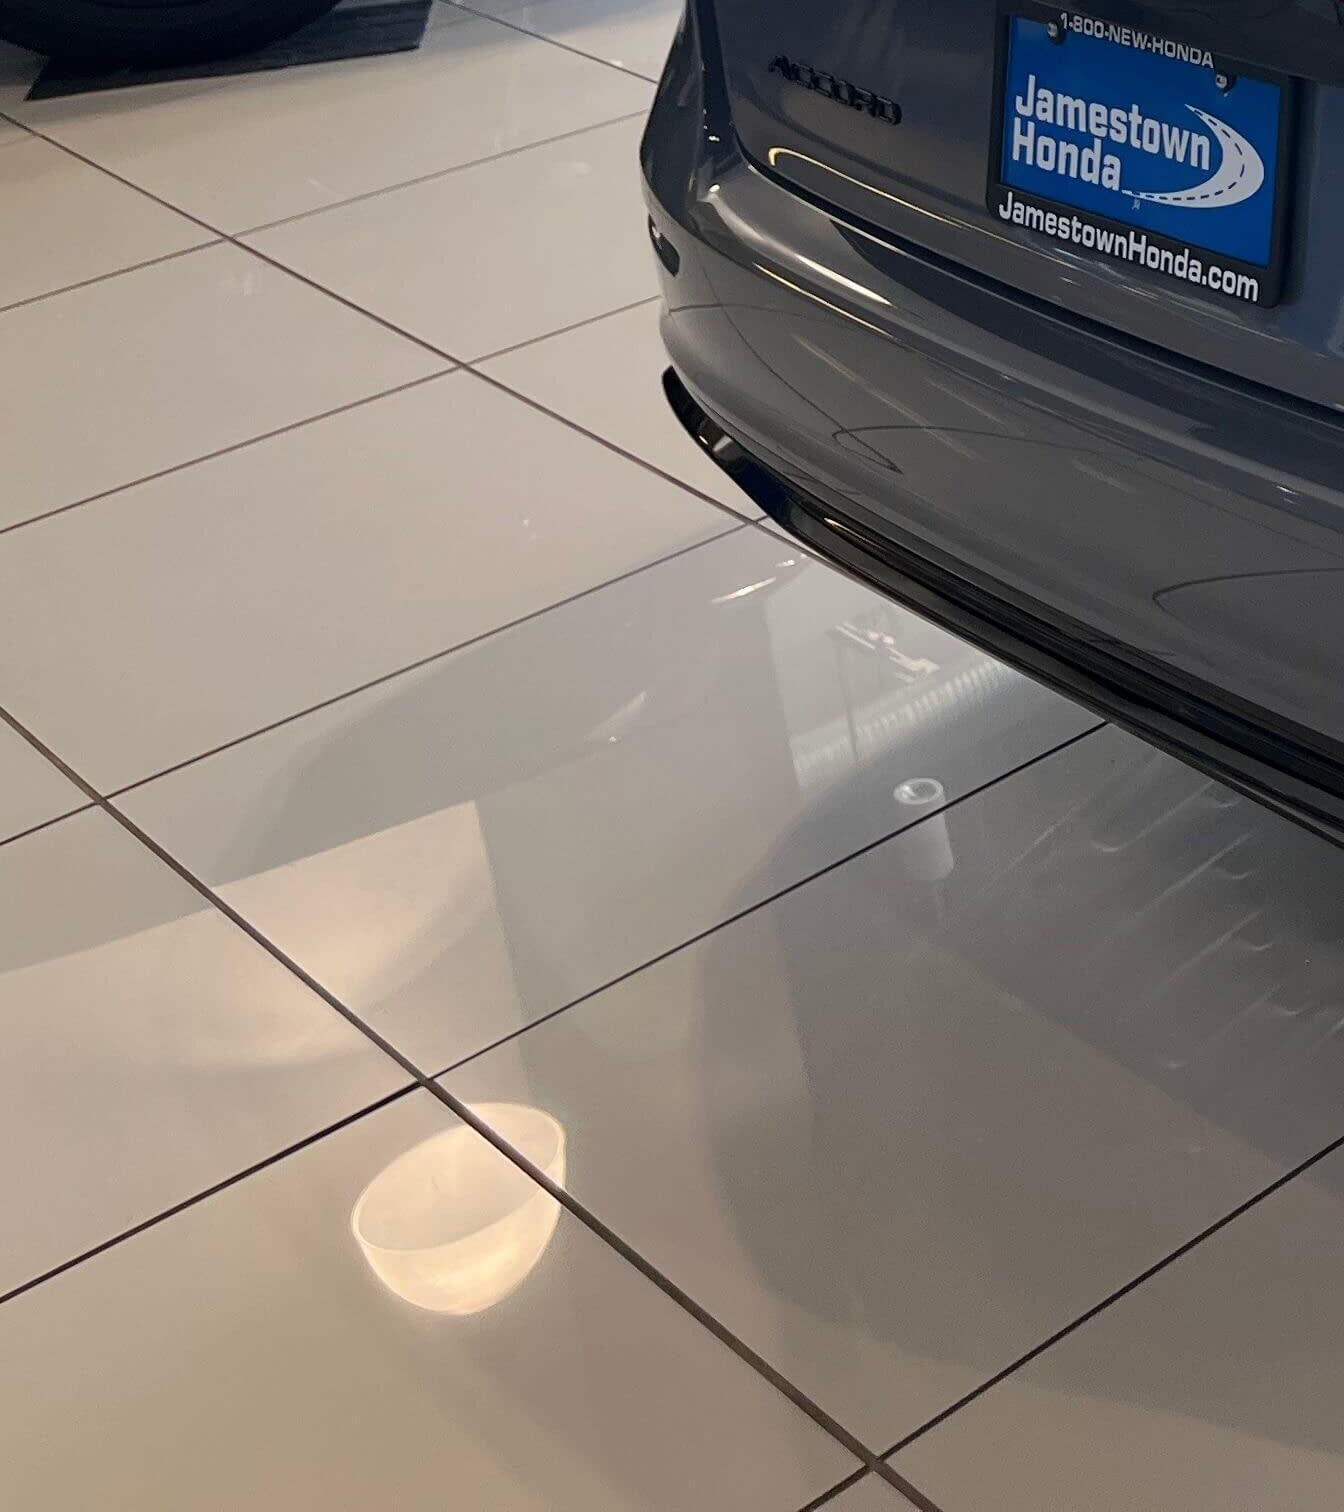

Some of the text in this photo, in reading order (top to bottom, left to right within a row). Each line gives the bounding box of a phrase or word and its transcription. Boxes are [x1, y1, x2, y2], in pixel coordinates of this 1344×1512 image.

[1060, 12, 1214, 69] 1-800-NEW-HONDA
[1012, 117, 1122, 192] Honda
[1015, 74, 1210, 171] Jamestown
[999, 192, 1259, 303] JamestownHonda.com
